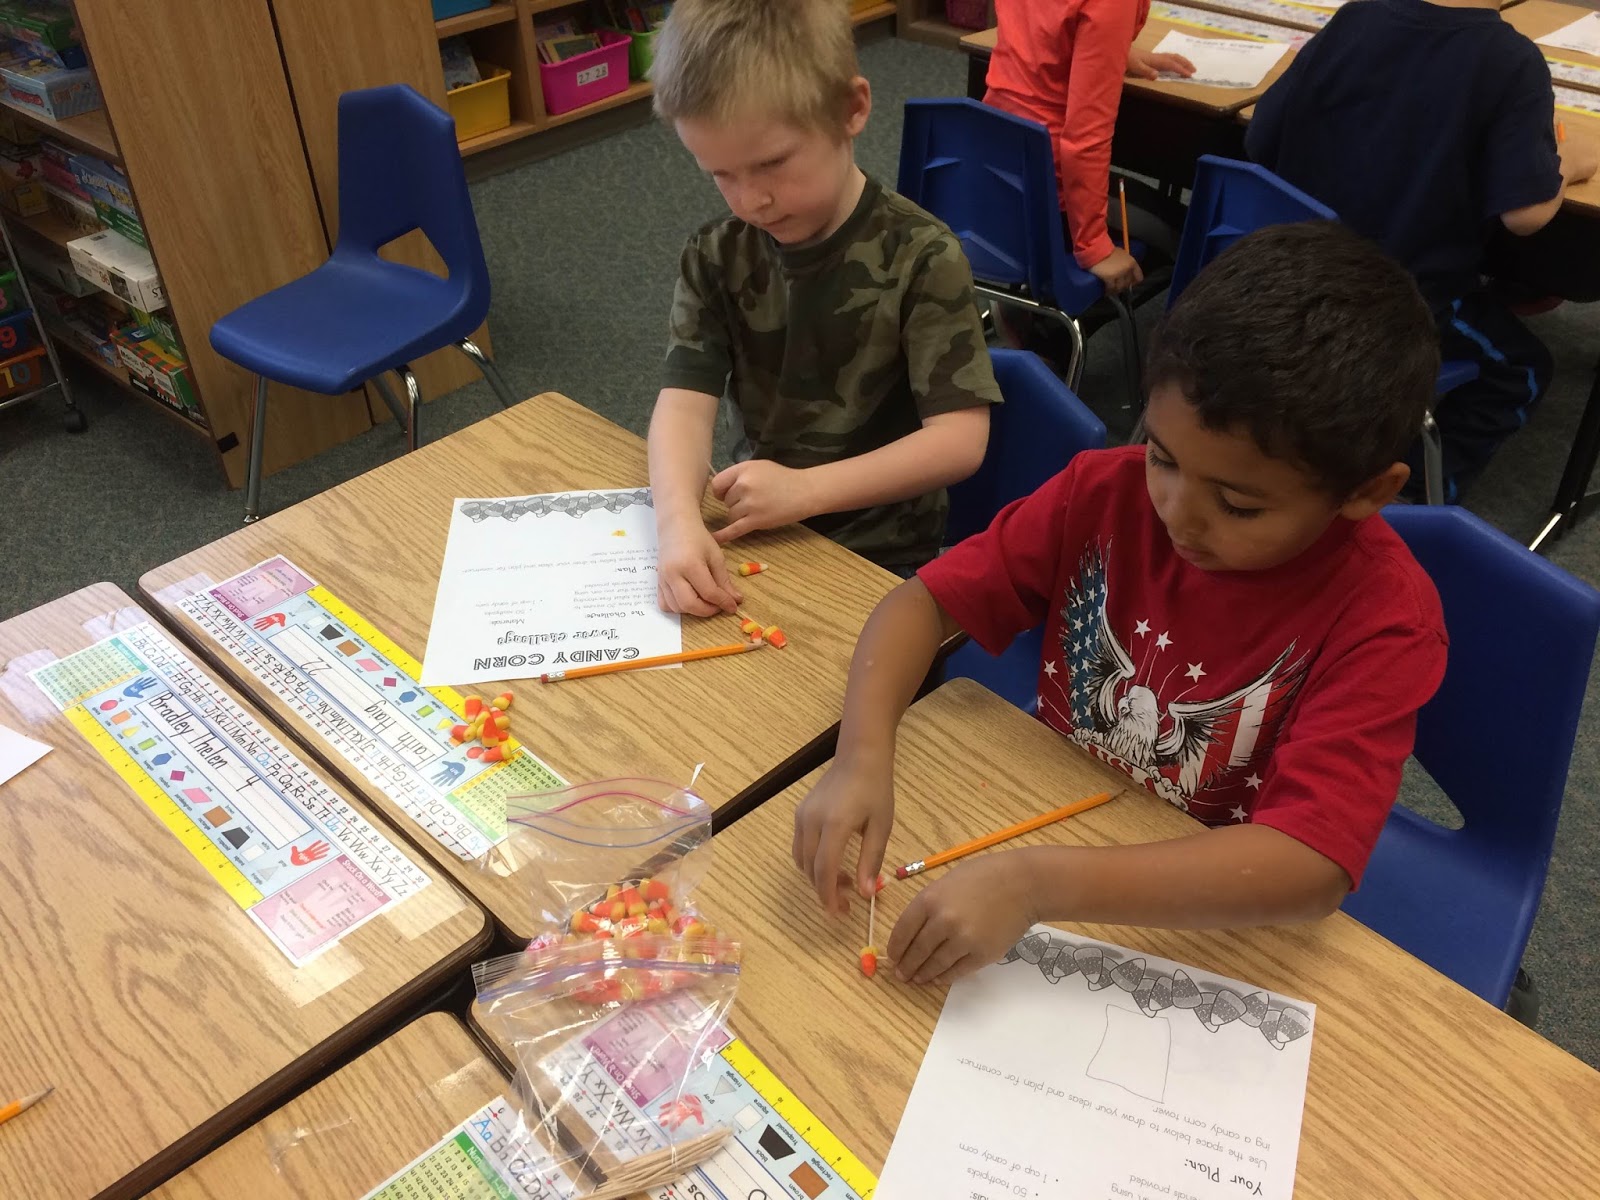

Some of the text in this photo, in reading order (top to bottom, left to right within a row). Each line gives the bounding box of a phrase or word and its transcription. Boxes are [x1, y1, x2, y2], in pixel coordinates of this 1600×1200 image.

[0, 326, 17, 349] 9
[0, 363, 31, 388] 10
[572, 628, 618, 641] Tower
[132, 637, 149, 650] Bb
[142, 646, 157, 659] Cc
[472, 646, 639, 670] CANDY CORN
[151, 655, 169, 668] Dd
[299, 656, 332, 677] 22
[168, 671, 187, 683] Ff
[177, 680, 193, 696] Gg
[187, 689, 205, 703] Hh
[201, 704, 220, 718] Jj
[211, 711, 228, 725] Kk
[149, 692, 237, 768] Bradley Thelen
[220, 720, 238, 732] Ll
[354, 699, 434, 767] Faith Haig
[228, 728, 246, 745] Mm
[242, 740, 259, 755] Nn
[254, 751, 275, 766] Oo
[265, 762, 282, 777] Pp
[235, 774, 262, 791] 4
[277, 773, 293, 793] Qq
[289, 784, 306, 798] Rr
[301, 796, 317, 810] Ss
[314, 805, 331, 820] Tt
[323, 815, 345, 832] Uu
[336, 827, 352, 842] Vv
[298, 852, 309, 862] right
[348, 839, 368, 859] Ww
[365, 855, 383, 872] Xx
[341, 859, 357, 873] Stuck
[352, 871, 363, 880] On
[365, 881, 383, 899] Word?
[378, 867, 397, 886] Yy
[390, 879, 408, 896] Zz
[1002, 1072, 1020, 1086] for
[1021, 1076, 1044, 1094] plan
[593, 1079, 613, 1103] Xx
[1045, 1086, 1064, 1100] and
[572, 1092, 597, 1118] 27 28
[1066, 1094, 1092, 1109] ideas
[1094, 1102, 1118, 1117] your
[612, 1099, 635, 1131] Ww
[1119, 1112, 1146, 1128] draw
[1182, 1115, 1207, 1128] corn
[725, 1070, 832, 1180] rectangle trapezoid square triangle
[1148, 1122, 1159, 1132] to
[1209, 1122, 1241, 1142] candy
[1161, 1126, 1191, 1144] below
[1243, 1135, 1251, 1143] a
[472, 1117, 495, 1141] Aa
[507, 1157, 527, 1182] Cc
[703, 1093, 804, 1200] brown black gray
[958, 1142, 978, 1154] corn
[1194, 1135, 1224, 1153] space
[1253, 1136, 1271, 1151] ing
[980, 1149, 1008, 1167] candy
[1226, 1148, 1244, 1162] the
[1246, 1154, 1268, 1170] Use
[433, 1162, 442, 1171] 22
[439, 1169, 448, 1178] 23
[445, 1177, 454, 1186] 24
[444, 1155, 452, 1163] 12
[450, 1163, 457, 1171] 13
[455, 1170, 463, 1178] 14
[1008, 1161, 1021, 1173] of
[1023, 1164, 1041, 1177] cup
[965, 1165, 1028, 1197] 50 toothpicks
[1181, 1157, 1265, 1197] Your Plan:
[1109, 1182, 1135, 1198] using
